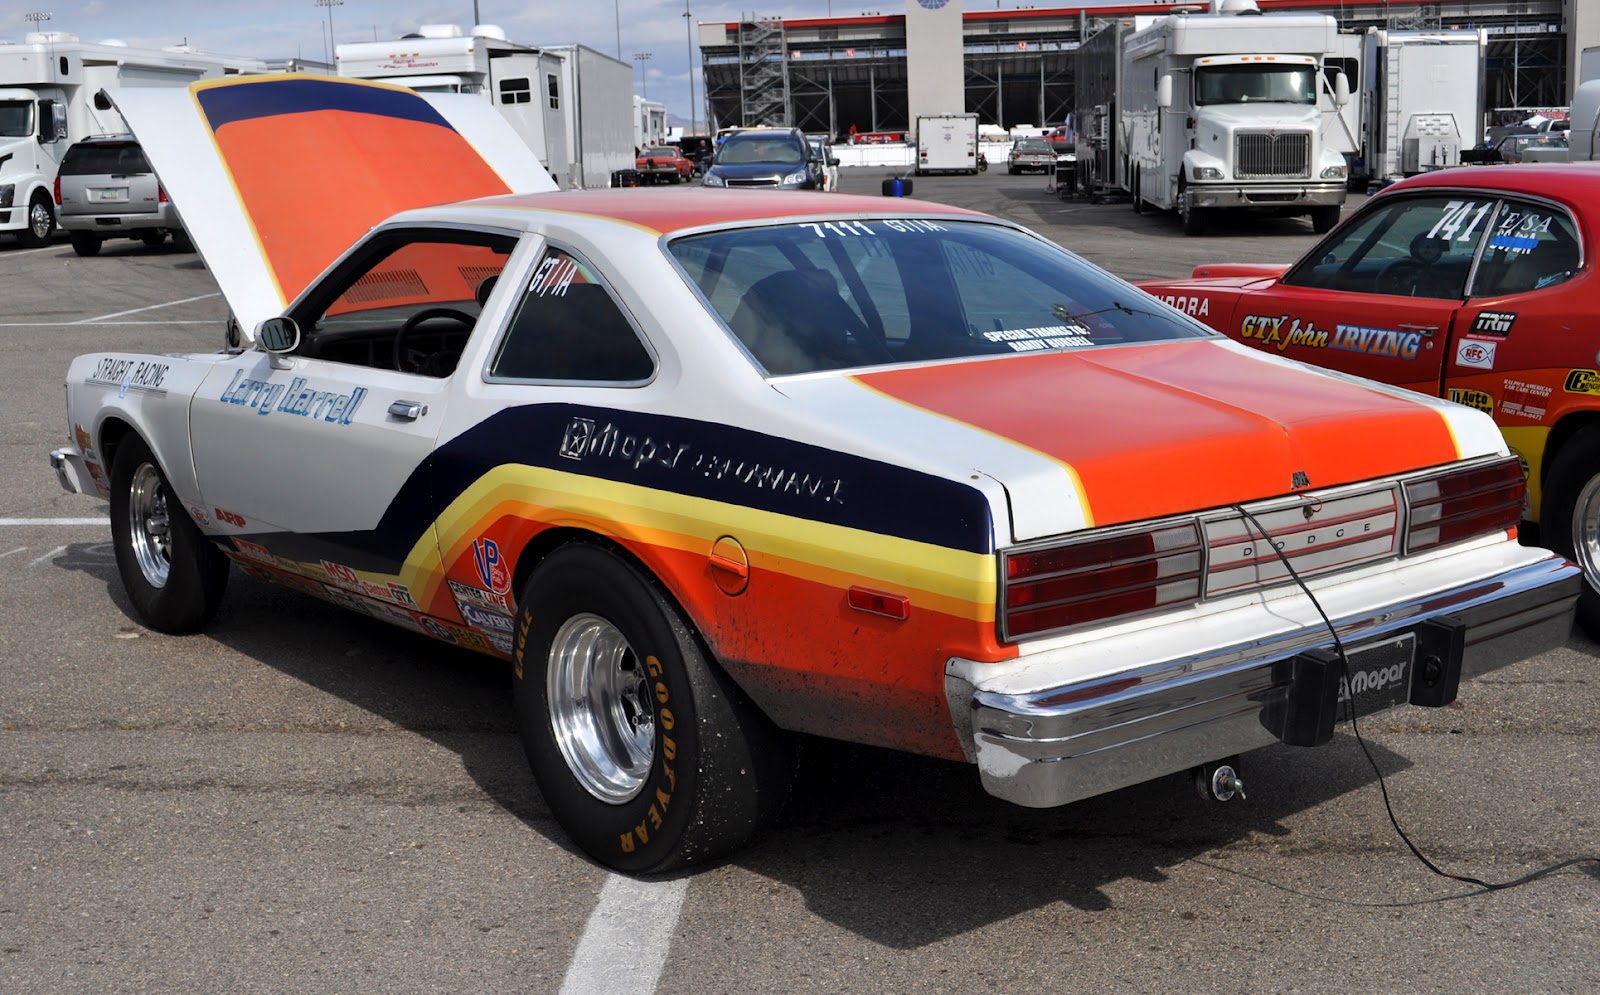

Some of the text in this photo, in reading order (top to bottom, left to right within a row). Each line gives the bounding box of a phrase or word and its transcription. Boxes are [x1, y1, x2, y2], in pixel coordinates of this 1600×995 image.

[797, 221, 876, 238] 7111
[1426, 201, 1493, 242] 741
[1499, 212, 1552, 237] E/SA
[983, 328, 1034, 342] SPECIAL
[1025, 325, 1073, 338] THANKS
[1476, 312, 1516, 332] TRW
[1241, 315, 1421, 360] GTX John IRVING
[1465, 348, 1483, 360] RFC
[93, 358, 169, 388] STRAIGHT RACING
[220, 368, 368, 425] Larry Harrell
[1461, 402, 1493, 415] ter
[1462, 391, 1488, 404] Auto
[214, 508, 246, 528] ARP
[1243, 523, 1371, 557] DODGE
[321, 560, 360, 584] MSD
[473, 538, 499, 590] VP
[1351, 662, 1407, 695] Mopar
[619, 655, 678, 853] GOODYEAR
